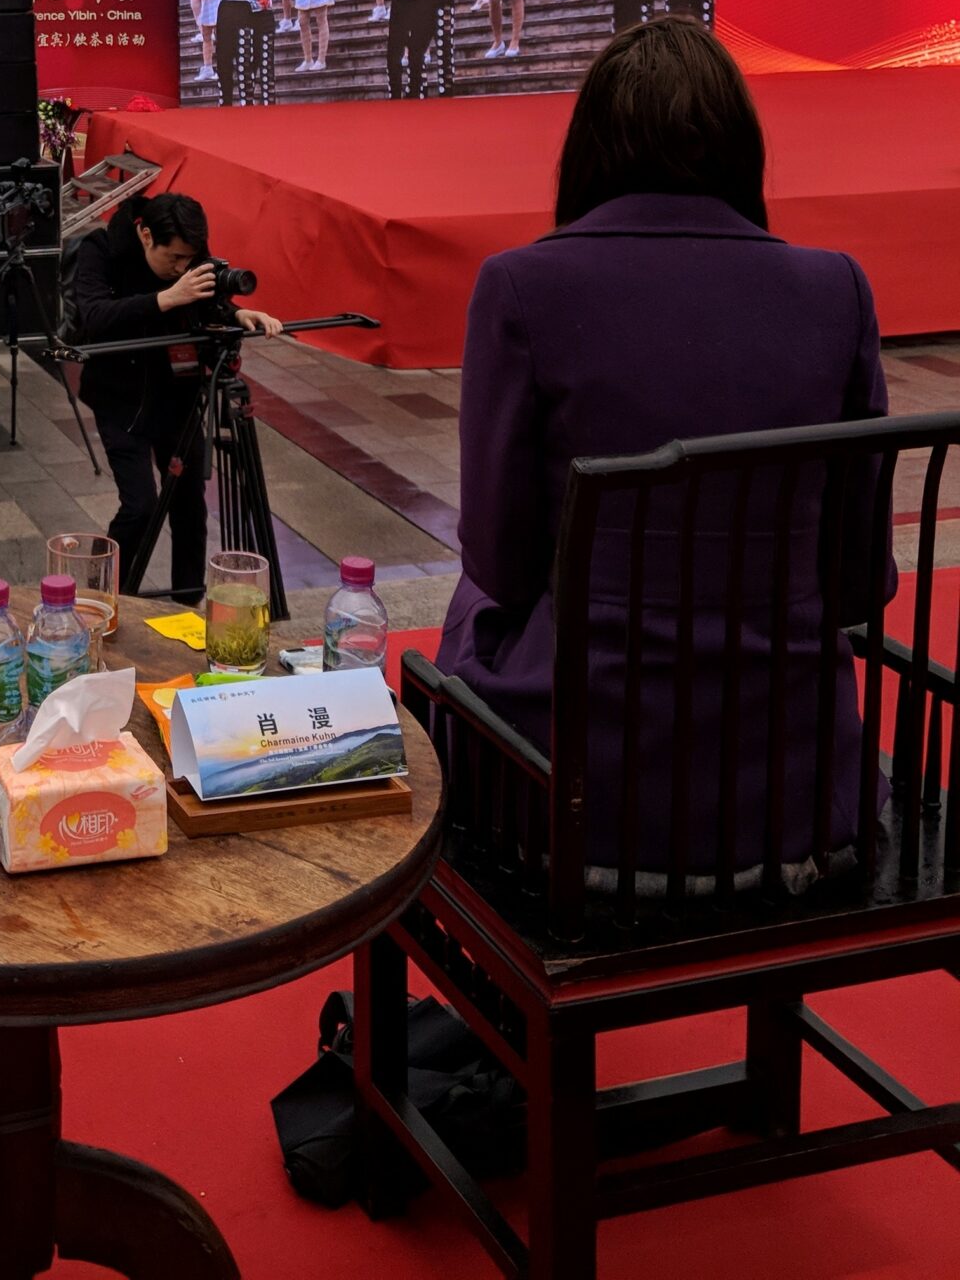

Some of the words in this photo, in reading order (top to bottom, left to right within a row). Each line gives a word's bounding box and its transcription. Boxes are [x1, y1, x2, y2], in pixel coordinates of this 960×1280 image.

[68, 10, 97, 21] Yibin
[107, 10, 142, 21] China
[256, 713, 279, 736] 肖
[307, 706, 333, 730] 漫
[260, 734, 310, 748] Charmaine
[312, 731, 337, 741] Kuhn
[58, 812, 118, 840] 心相印
